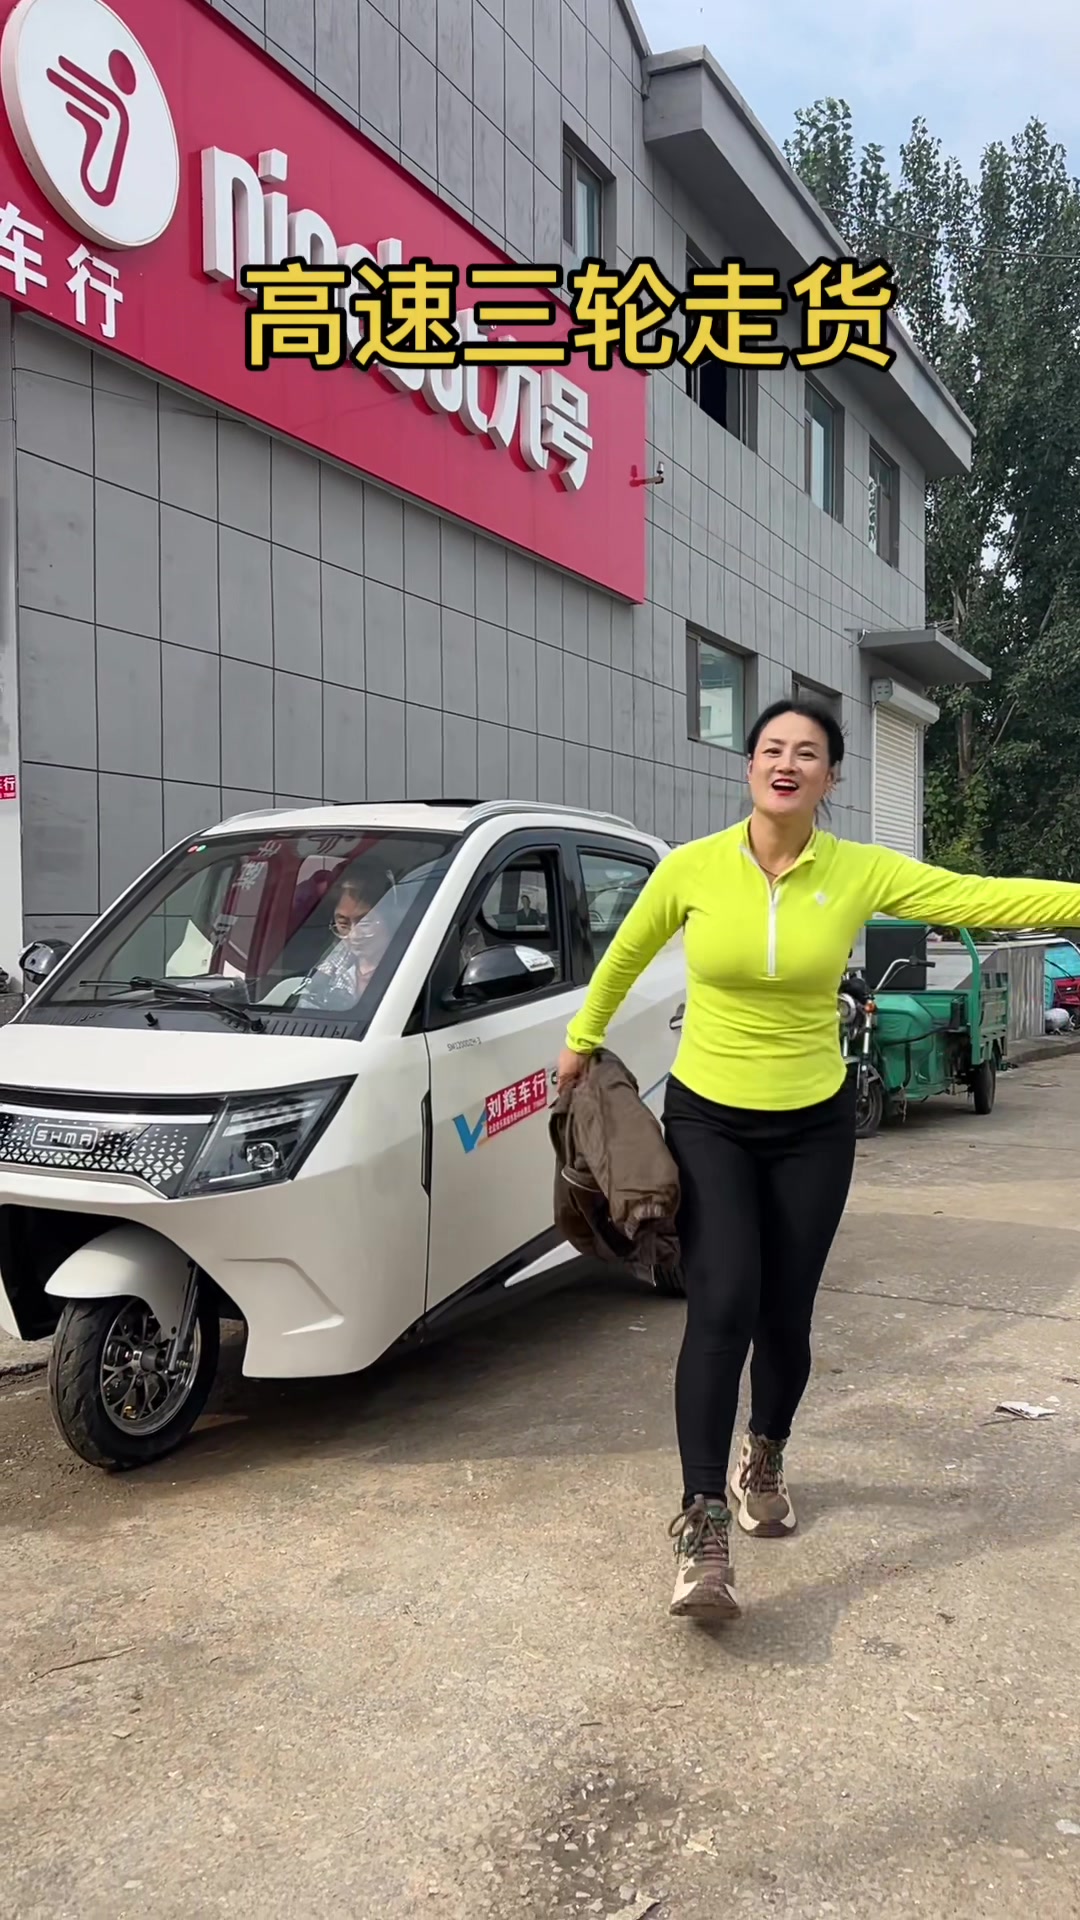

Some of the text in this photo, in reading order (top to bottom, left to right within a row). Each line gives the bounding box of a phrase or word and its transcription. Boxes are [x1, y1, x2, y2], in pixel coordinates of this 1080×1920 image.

[0, 201, 123, 338] 车行
[0, 777, 15, 791] 行
[487, 1073, 545, 1121] 刘辉车行
[36, 1129, 92, 1147] SHMA
